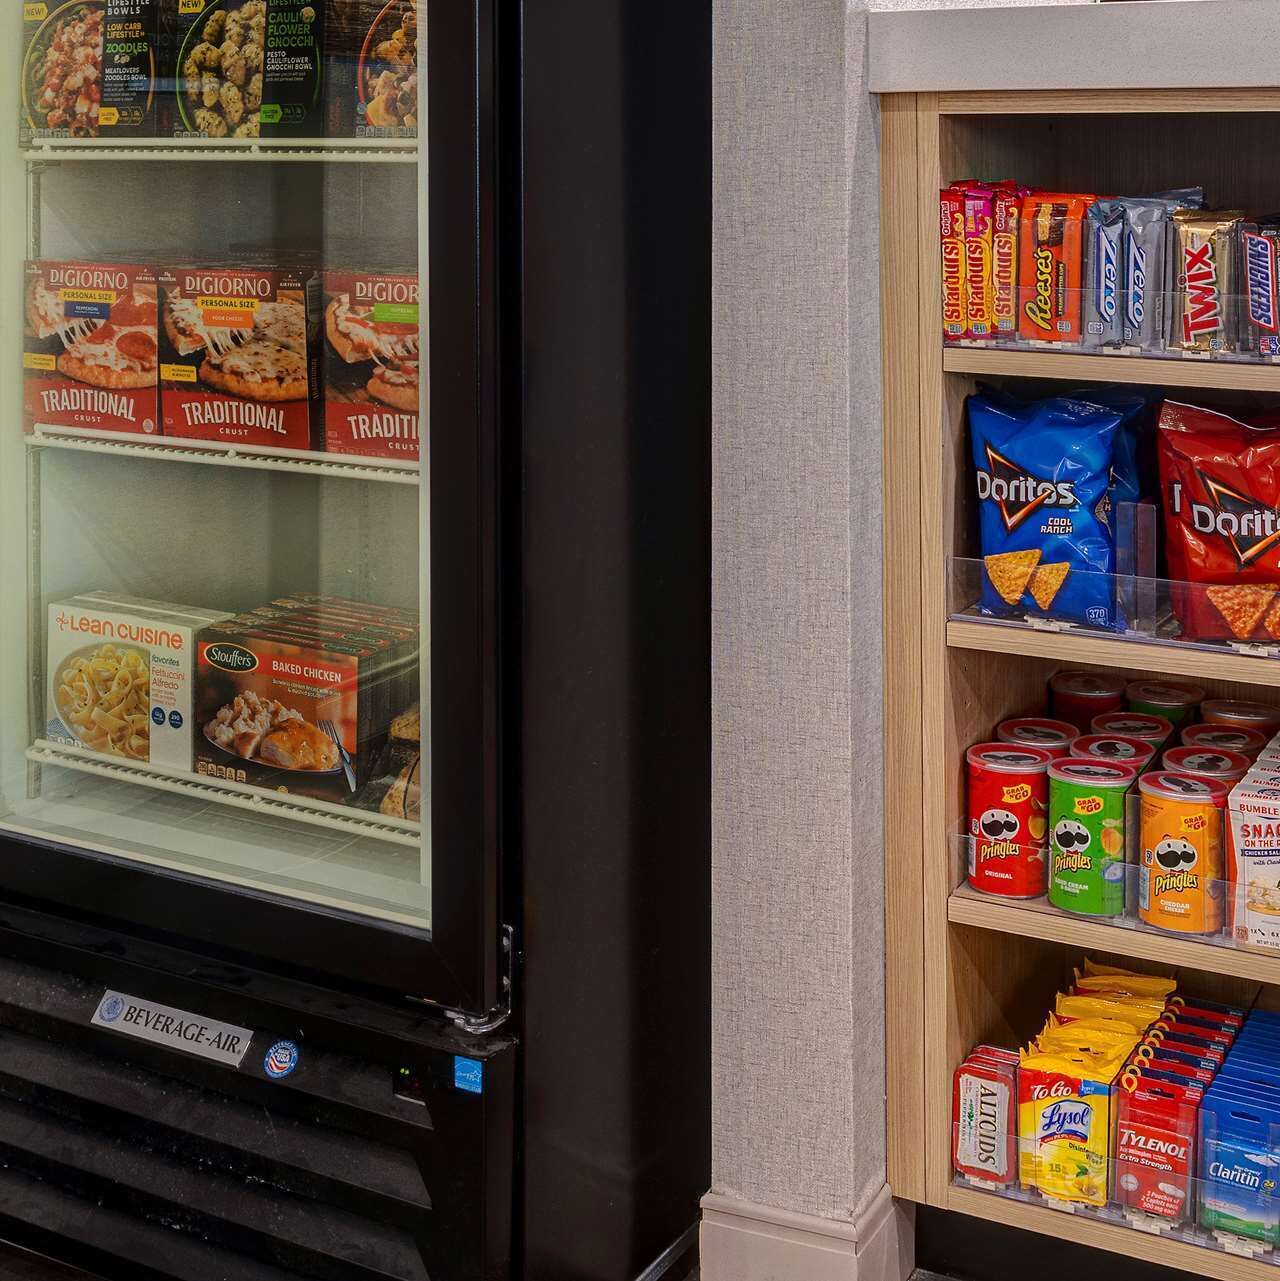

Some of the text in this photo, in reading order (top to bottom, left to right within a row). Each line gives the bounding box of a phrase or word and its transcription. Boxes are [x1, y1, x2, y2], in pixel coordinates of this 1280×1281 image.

[107, 7, 140, 15] BOWLS
[1247, 235, 1273, 328] SNICKERS
[201, 300, 238, 308] PERSONAL
[1183, 243, 1220, 347] TWIX
[40, 389, 137, 423] TRADITIONAL
[74, 414, 101, 423] CRUST
[181, 401, 287, 435] TRADITIONAL
[219, 427, 248, 436] CRUST
[977, 470, 1075, 505] Doritos
[1040, 525, 1073, 534] RANCH
[1048, 517, 1072, 526] COOL
[1089, 608, 1105, 620] 370
[272, 661, 341, 683] BAKED CHICKEN
[1006, 786, 1024, 795] GRAB
[1077, 798, 1096, 806] GRAB
[1240, 803, 1280, 817] BUMBLE
[1183, 815, 1204, 826] GRAB
[980, 841, 1020, 863] Pringles
[1245, 839, 1257, 848] ON
[1259, 839, 1274, 848] THE
[1055, 853, 1092, 875] Pringles
[984, 869, 1013, 880] ORIGINAL
[1155, 871, 1198, 895] Pringles
[123, 1004, 241, 1056] BEVERAGE-AIR
[1031, 1082, 1072, 1100] To Go
[978, 1085, 997, 1165] ALTOIDS
[1042, 1104, 1090, 1132] Lysol
[1120, 1129, 1187, 1159] TYLENOL
[1120, 1154, 1172, 1171] Extra Strength
[1209, 1162, 1260, 1188] Claritin
